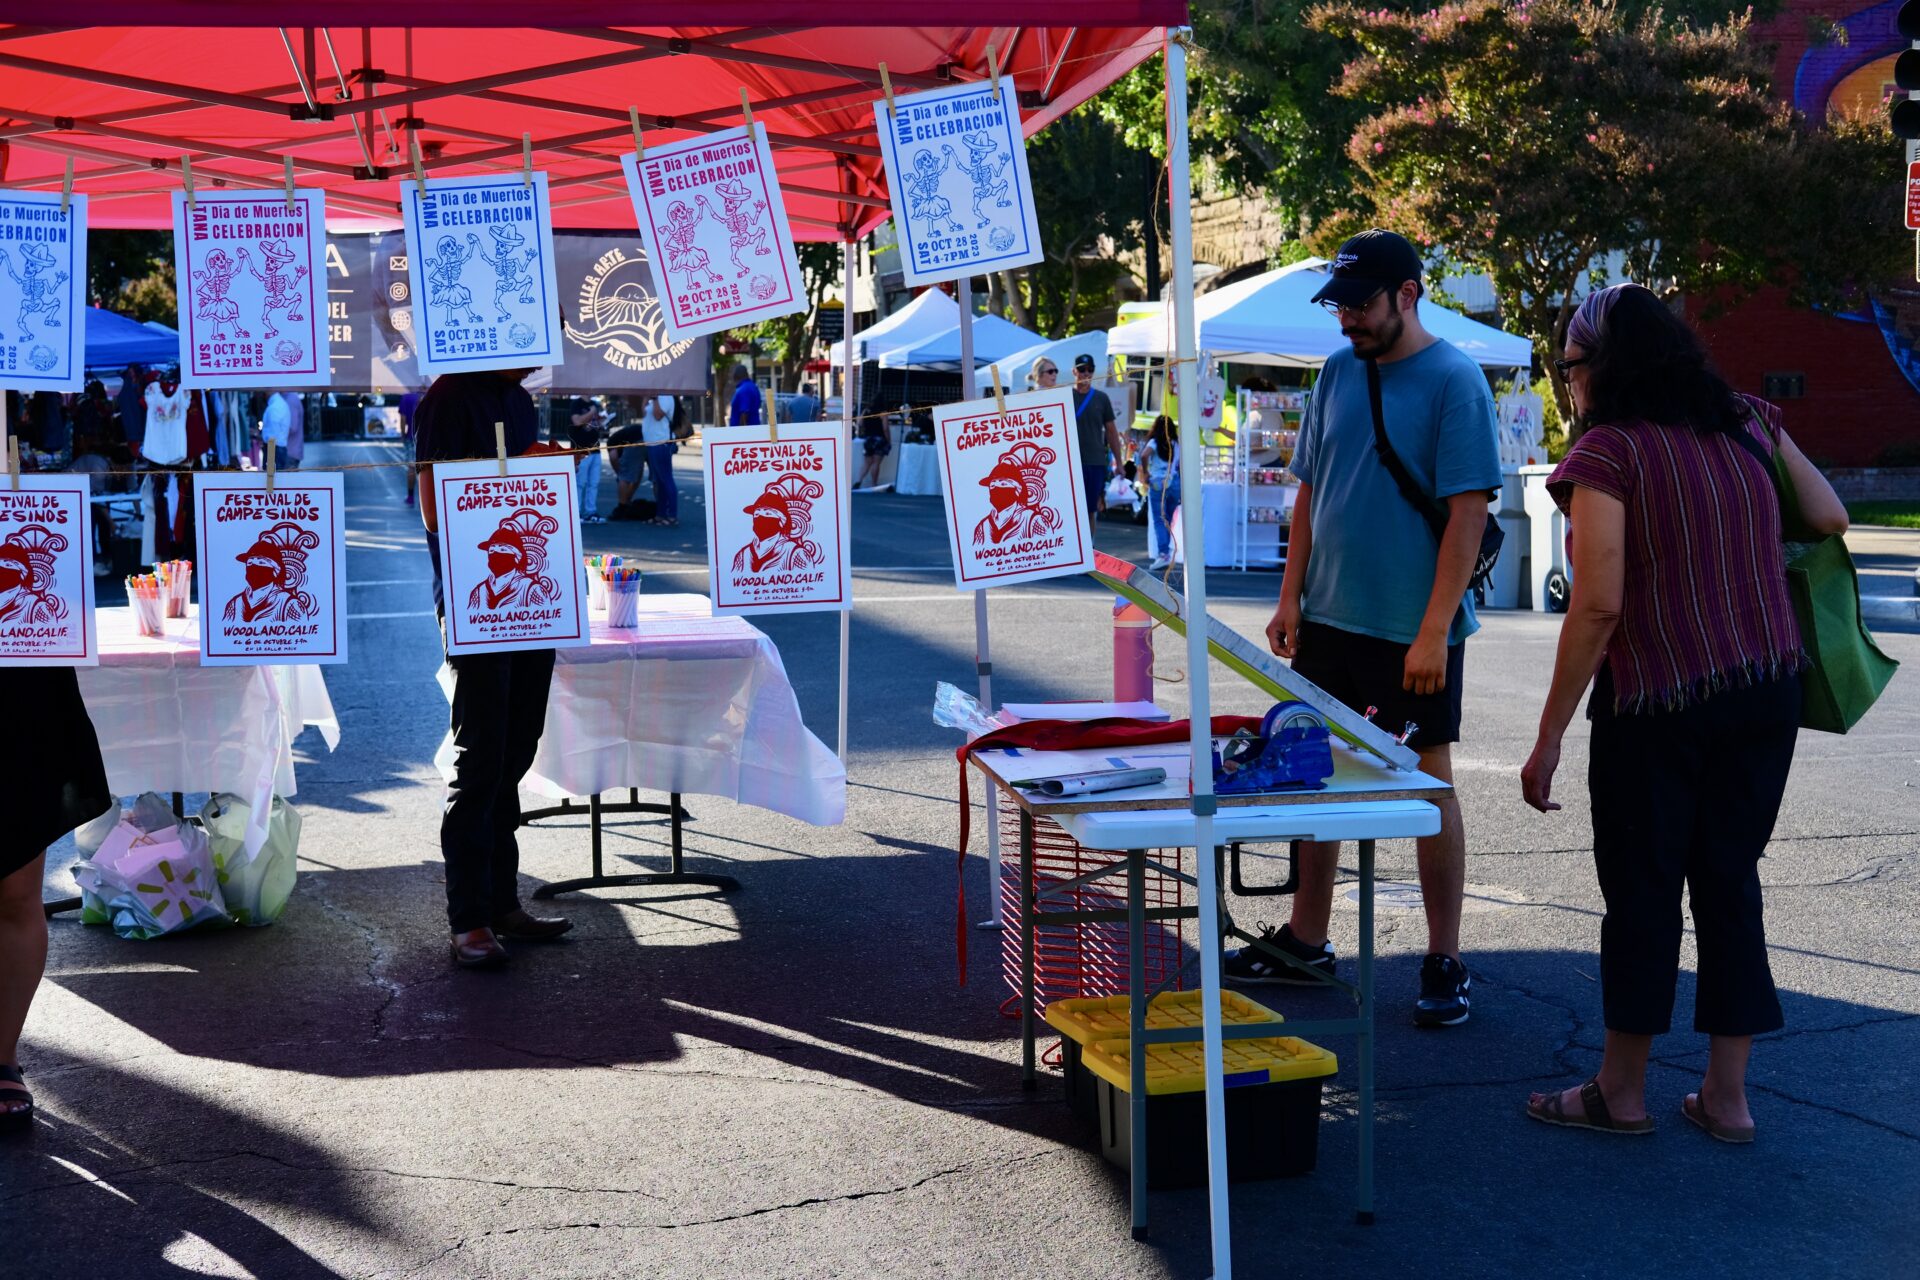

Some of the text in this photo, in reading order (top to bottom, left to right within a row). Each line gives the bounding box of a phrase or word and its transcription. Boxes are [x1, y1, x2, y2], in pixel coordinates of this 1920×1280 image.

[913, 95, 1000, 121] Dia de Muertos
[896, 109, 914, 145] TANA
[916, 111, 1003, 140] CELEBRACION
[664, 142, 751, 173] Dia de Muertos
[645, 162, 666, 198] TANA
[668, 158, 756, 192] CELEBRACION
[441, 189, 531, 206] Dia de Muertos
[14, 206, 67, 222] Muertos
[212, 206, 230, 218] Dia
[235, 206, 249, 218] de
[422, 193, 438, 229] TANA
[442, 206, 532, 226] CELEBRACION
[193, 206, 208, 240] TANA
[212, 223, 304, 239] CELEBRACION
[917, 242, 931, 265] SAT
[931, 236, 968, 251] OCT 28
[969, 233, 980, 257] 2023
[593, 247, 626, 275] ARTE
[932, 249, 970, 264] 4-7PM
[578, 275, 600, 323] TALLER
[678, 294, 693, 318] SAT
[691, 286, 728, 304] OCT 28
[729, 283, 742, 307] 2023
[694, 300, 731, 316] 4-7PM
[434, 330, 447, 354] SAT
[448, 328, 486, 341] OCT 28
[488, 327, 498, 351] 2023
[8, 345, 17, 370] 2023
[200, 344, 211, 368] SAT
[213, 344, 252, 355] OCT 28
[255, 343, 264, 367] 2023
[449, 342, 487, 354] 4-7PM
[603, 346, 624, 368] DEL
[214, 358, 252, 368] 4-7PM
[626, 354, 672, 371] NUEVO
[963, 412, 1045, 434] FESTIVAL DE
[957, 423, 1054, 451] CAMPESINOS
[731, 444, 815, 459] FESTIVAL DE
[724, 457, 823, 475] CAMPESINOS
[464, 479, 549, 495] FESTIVAL DE
[42, 495, 59, 508] DE
[224, 493, 311, 507] FESTIVAL DE
[456, 492, 557, 512] CAMPESINOS
[216, 506, 319, 522] CAMPESINOS
